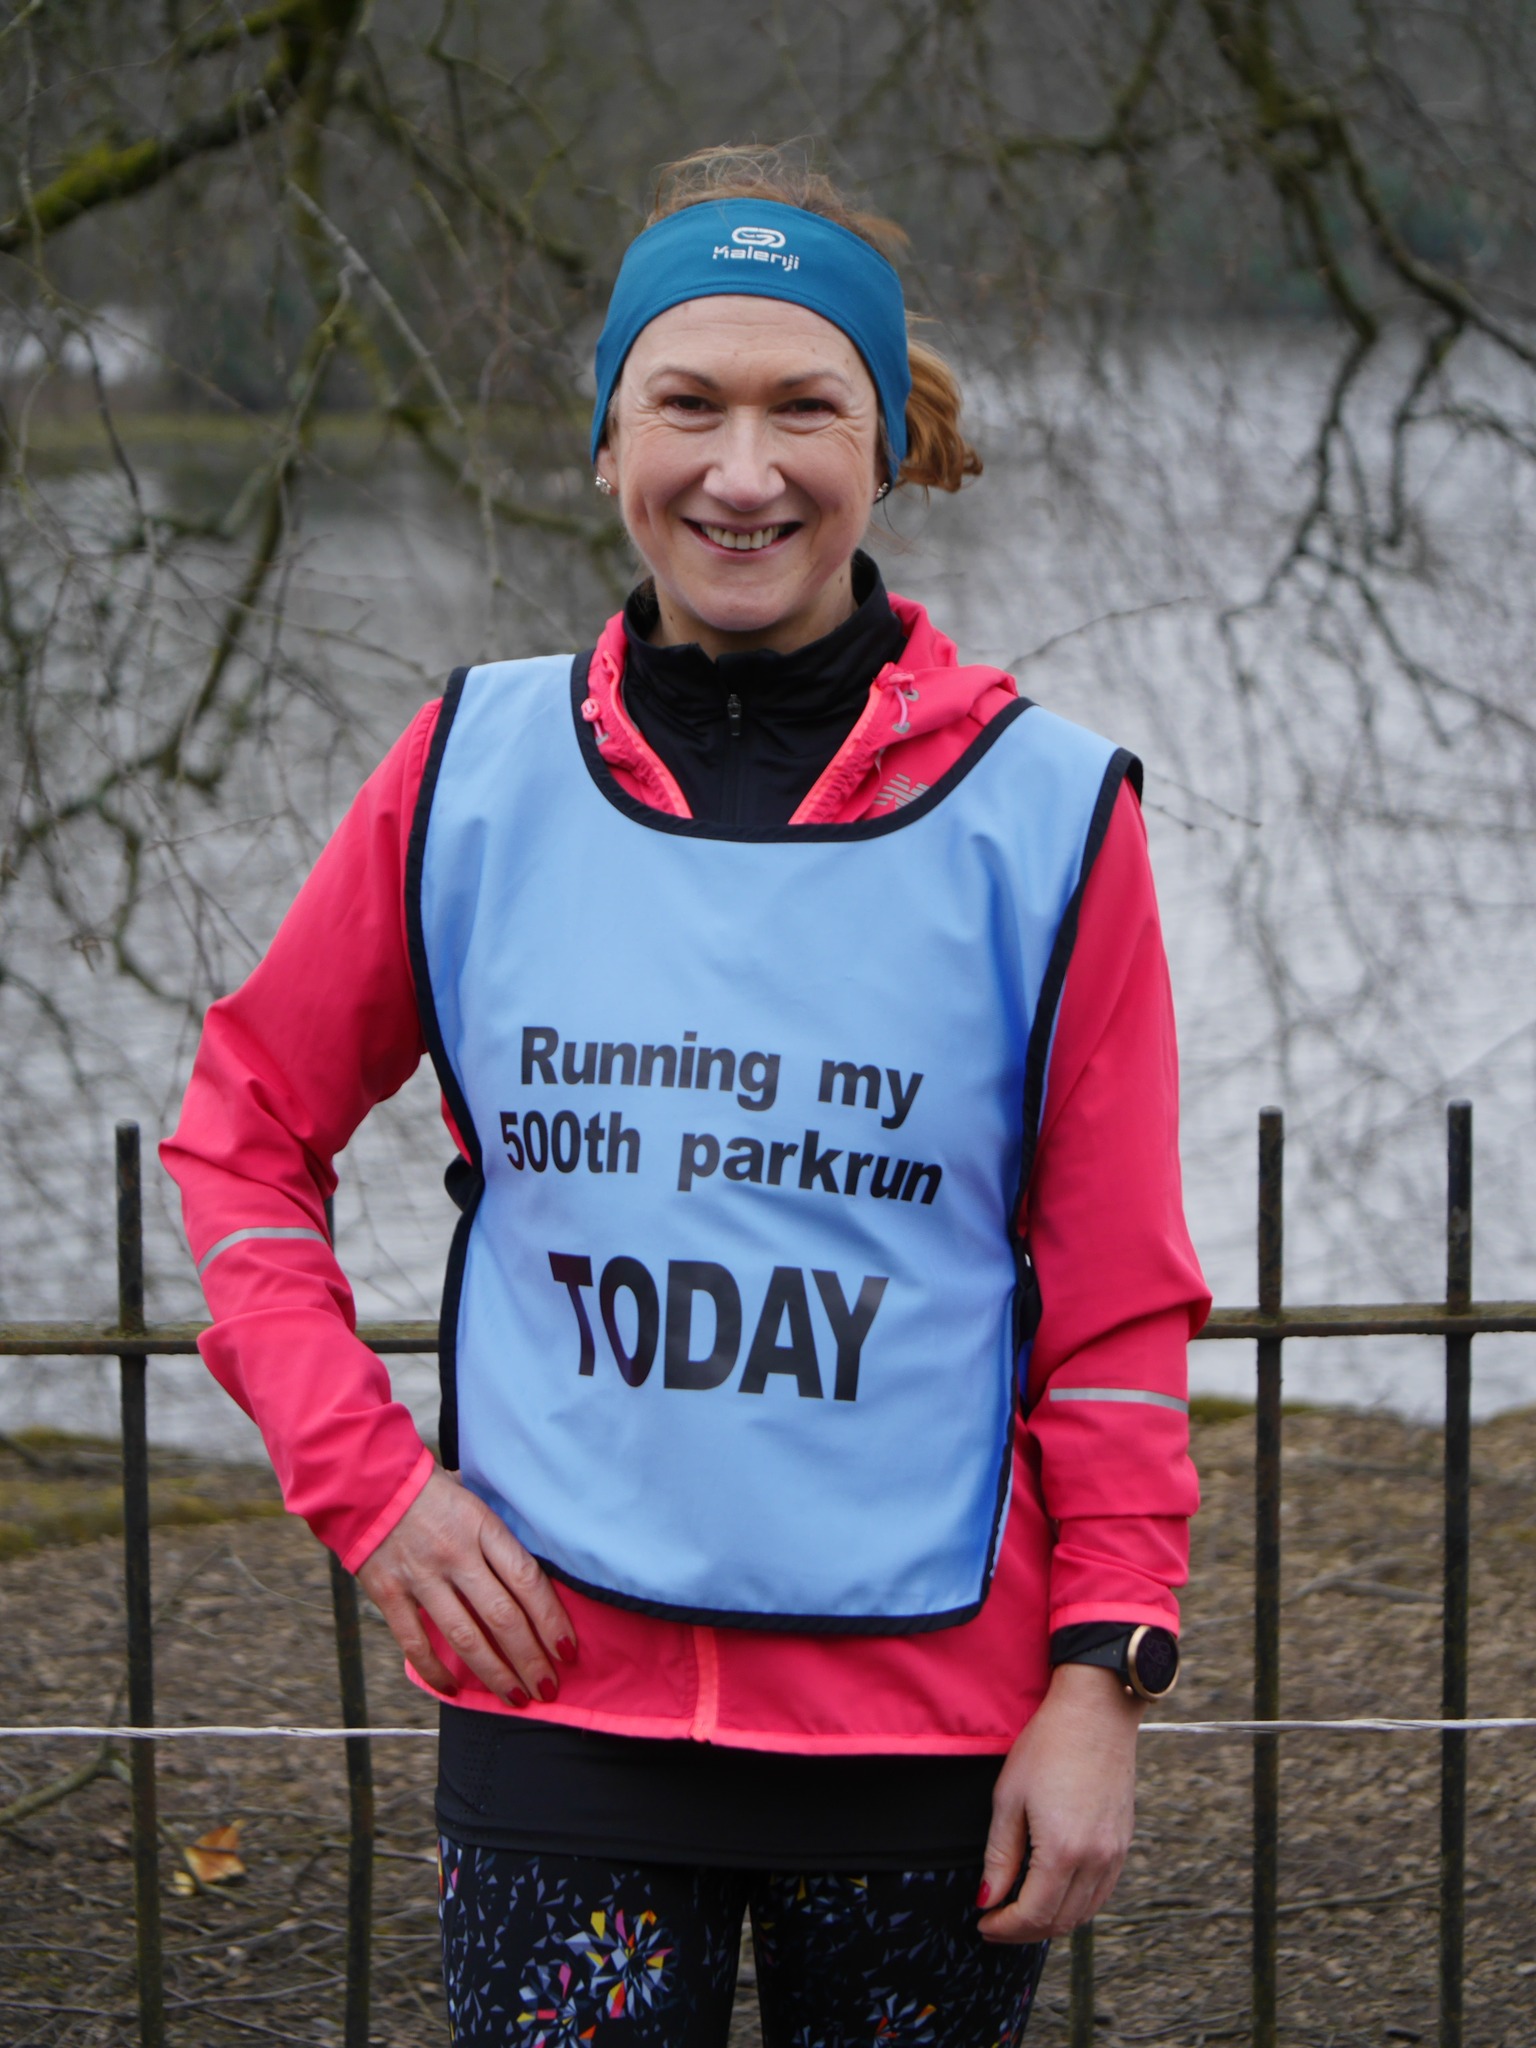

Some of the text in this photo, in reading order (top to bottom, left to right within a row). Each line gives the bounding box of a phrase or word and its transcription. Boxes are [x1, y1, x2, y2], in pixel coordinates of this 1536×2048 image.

[712, 245, 800, 272] Kalenji
[520, 1026, 924, 1130] Running my
[500, 1109, 943, 1205] 500th parkrun
[547, 1250, 890, 1402] TODAY
